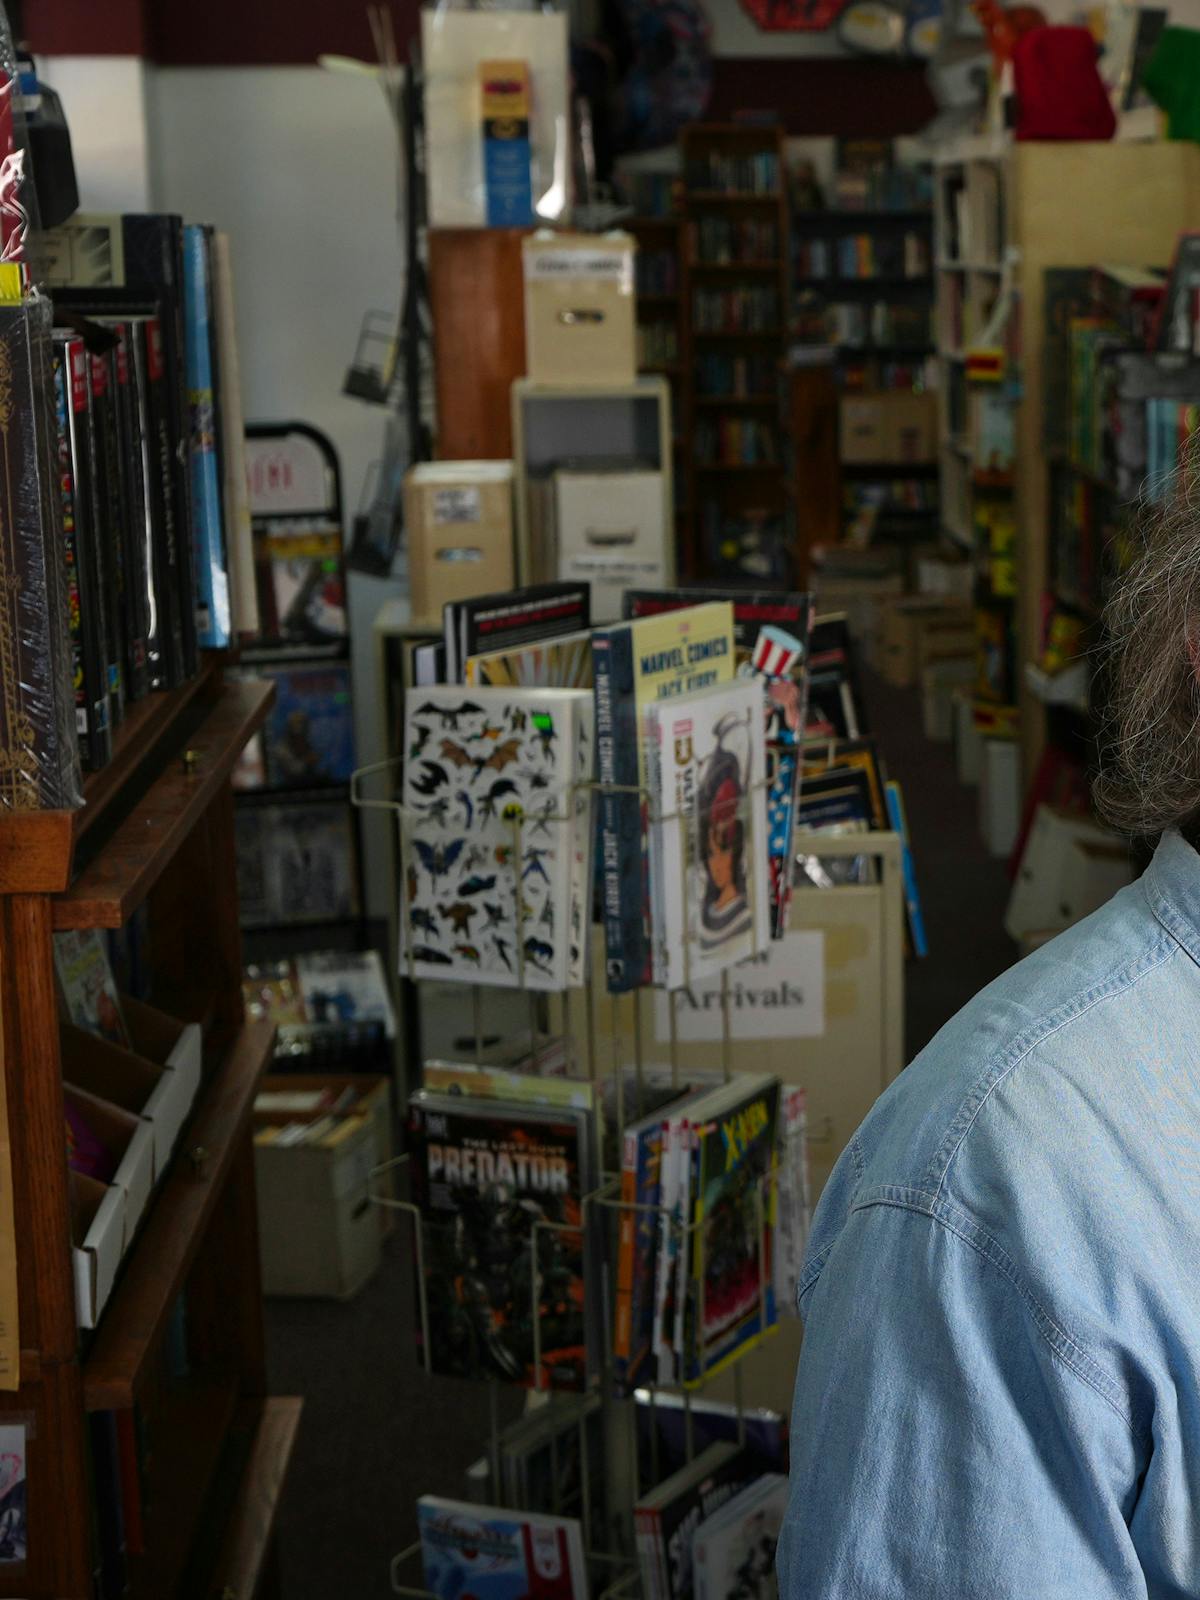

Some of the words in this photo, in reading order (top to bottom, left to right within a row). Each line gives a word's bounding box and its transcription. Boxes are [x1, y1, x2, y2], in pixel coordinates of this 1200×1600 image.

[640, 648, 684, 677] MARVEL
[687, 635, 728, 663] COMICS
[596, 673, 613, 734] MARVEL
[656, 680, 682, 699] JACK
[687, 669, 717, 691] KIRBY
[602, 828, 619, 869] JACK
[605, 872, 621, 918] KIRBY
[676, 981, 804, 1010] Arrivals
[426, 1142, 569, 1196] PREDATOR
